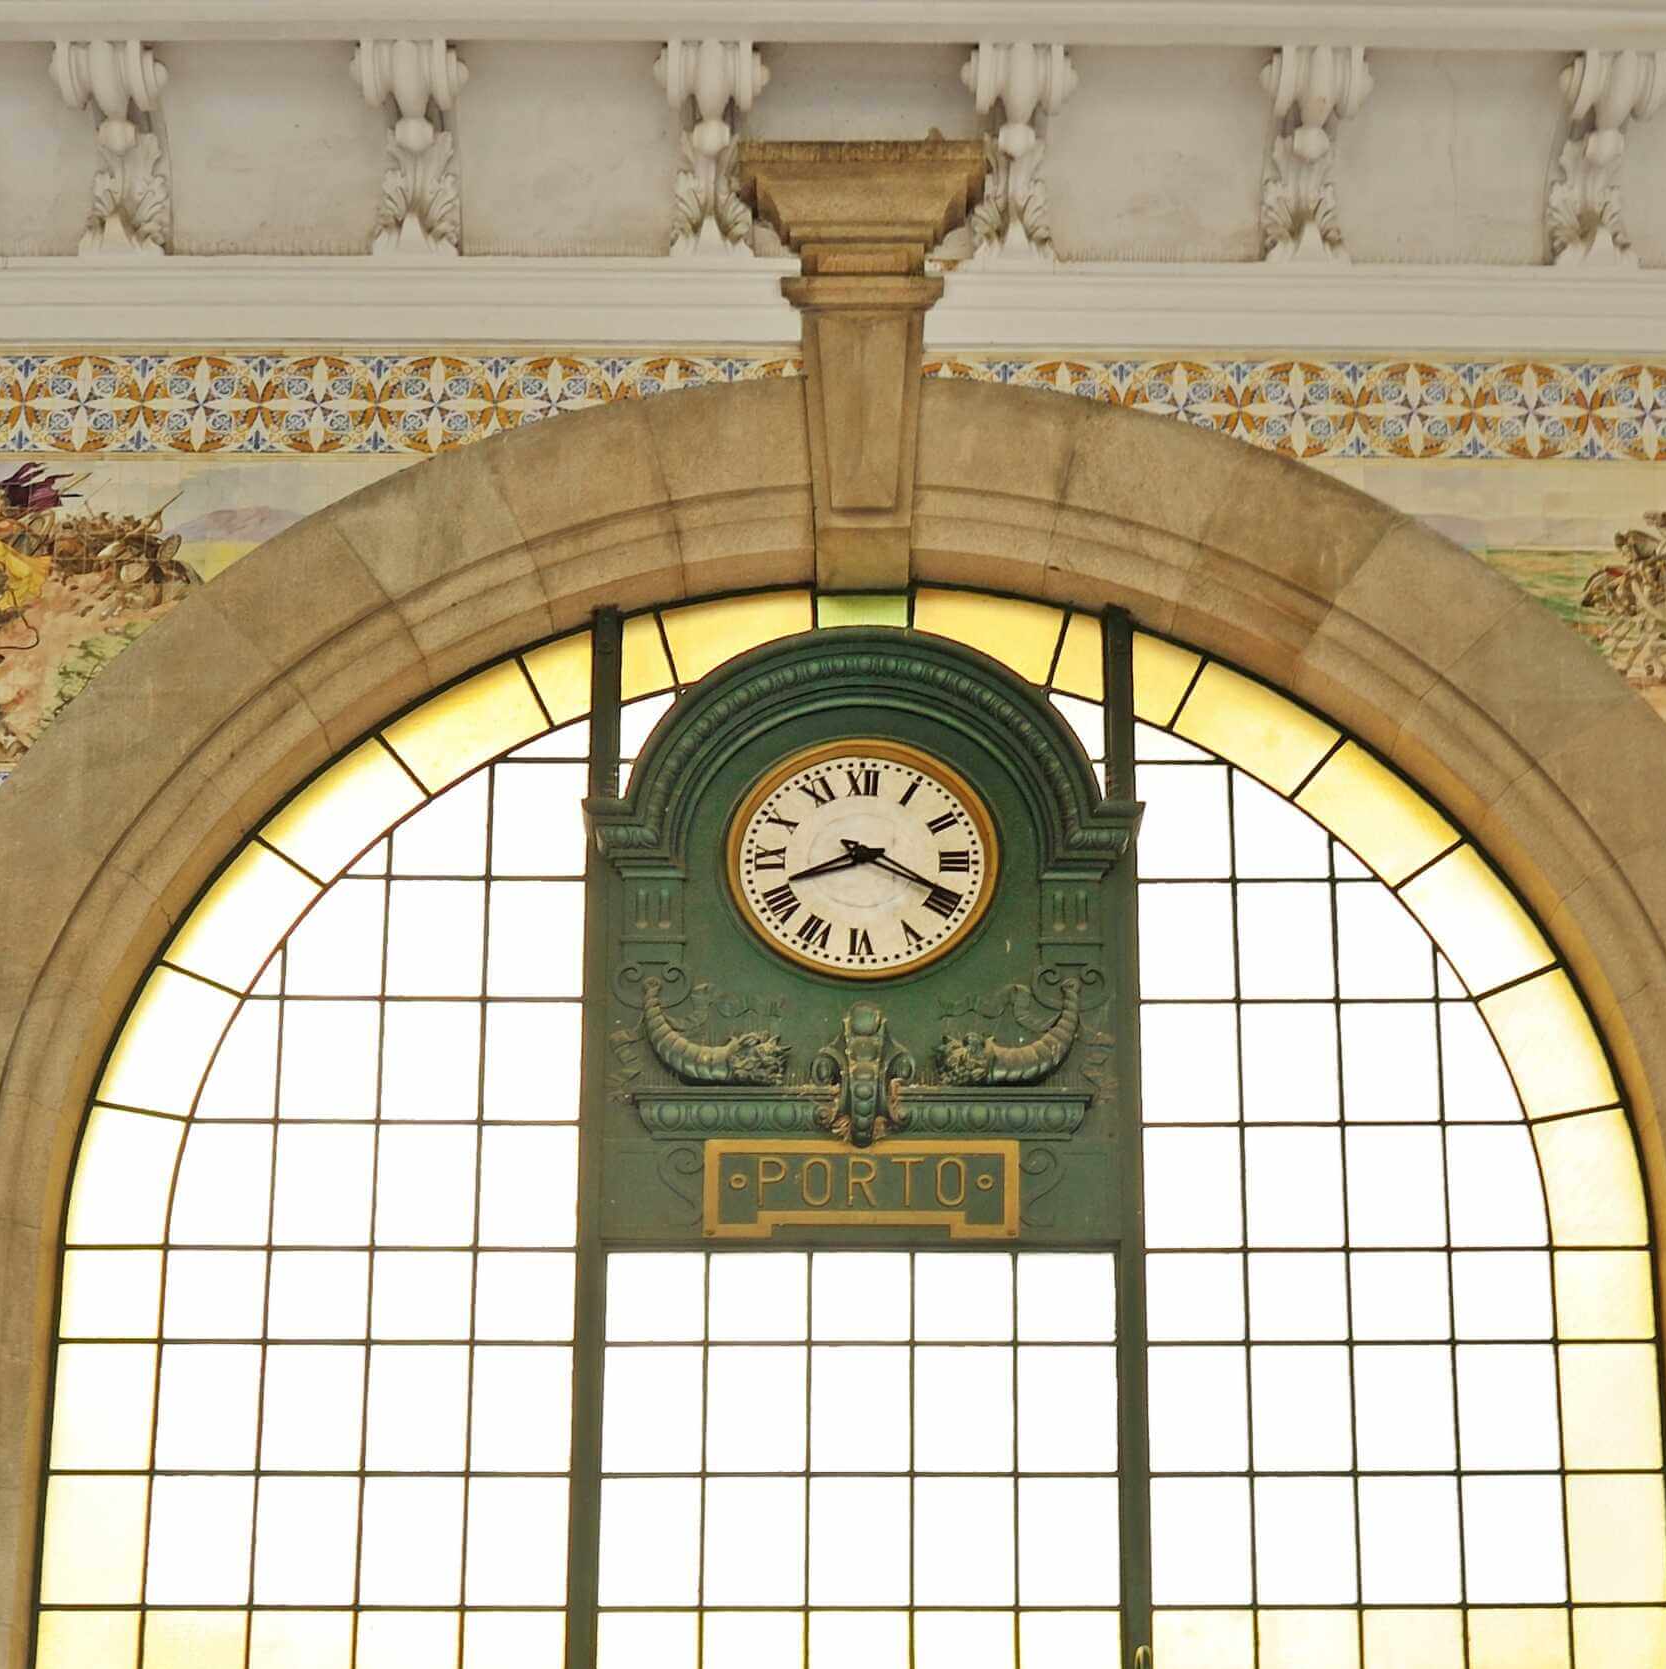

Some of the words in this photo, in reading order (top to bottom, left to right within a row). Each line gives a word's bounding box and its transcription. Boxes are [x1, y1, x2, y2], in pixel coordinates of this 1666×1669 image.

[799, 776, 836, 808] XI
[846, 770, 880, 797] XII
[766, 810, 800, 834] X
[926, 811, 958, 835] II
[754, 845, 787, 871] IX
[939, 850, 969, 873] III
[762, 884, 801, 925] VIII
[797, 913, 832, 949] VII
[849, 928, 874, 956] VI
[901, 920, 925, 947] V
[755, 1157, 966, 1207] PORTO
